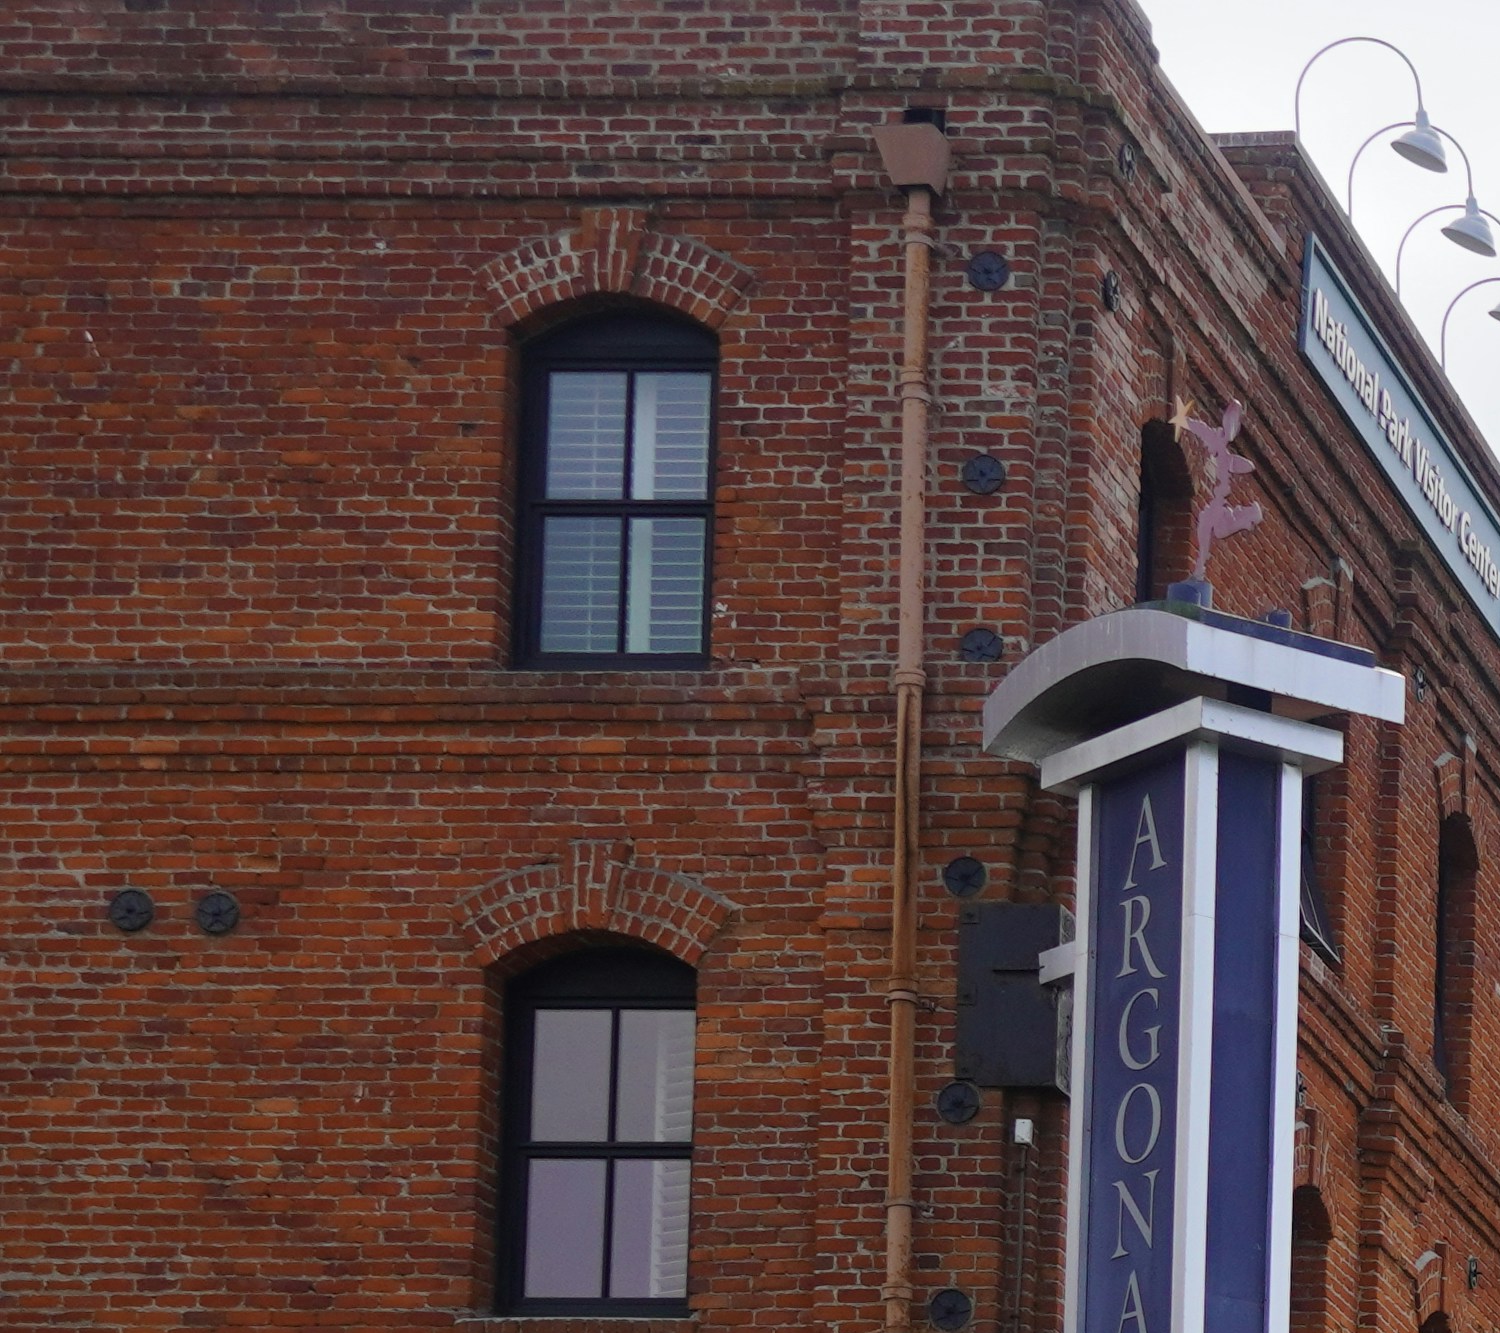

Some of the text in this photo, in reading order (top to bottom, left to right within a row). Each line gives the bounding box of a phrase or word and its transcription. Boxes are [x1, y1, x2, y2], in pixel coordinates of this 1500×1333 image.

[1312, 287, 1379, 418] National
[1378, 388, 1414, 471] Park
[1412, 435, 1461, 536] Visitor
